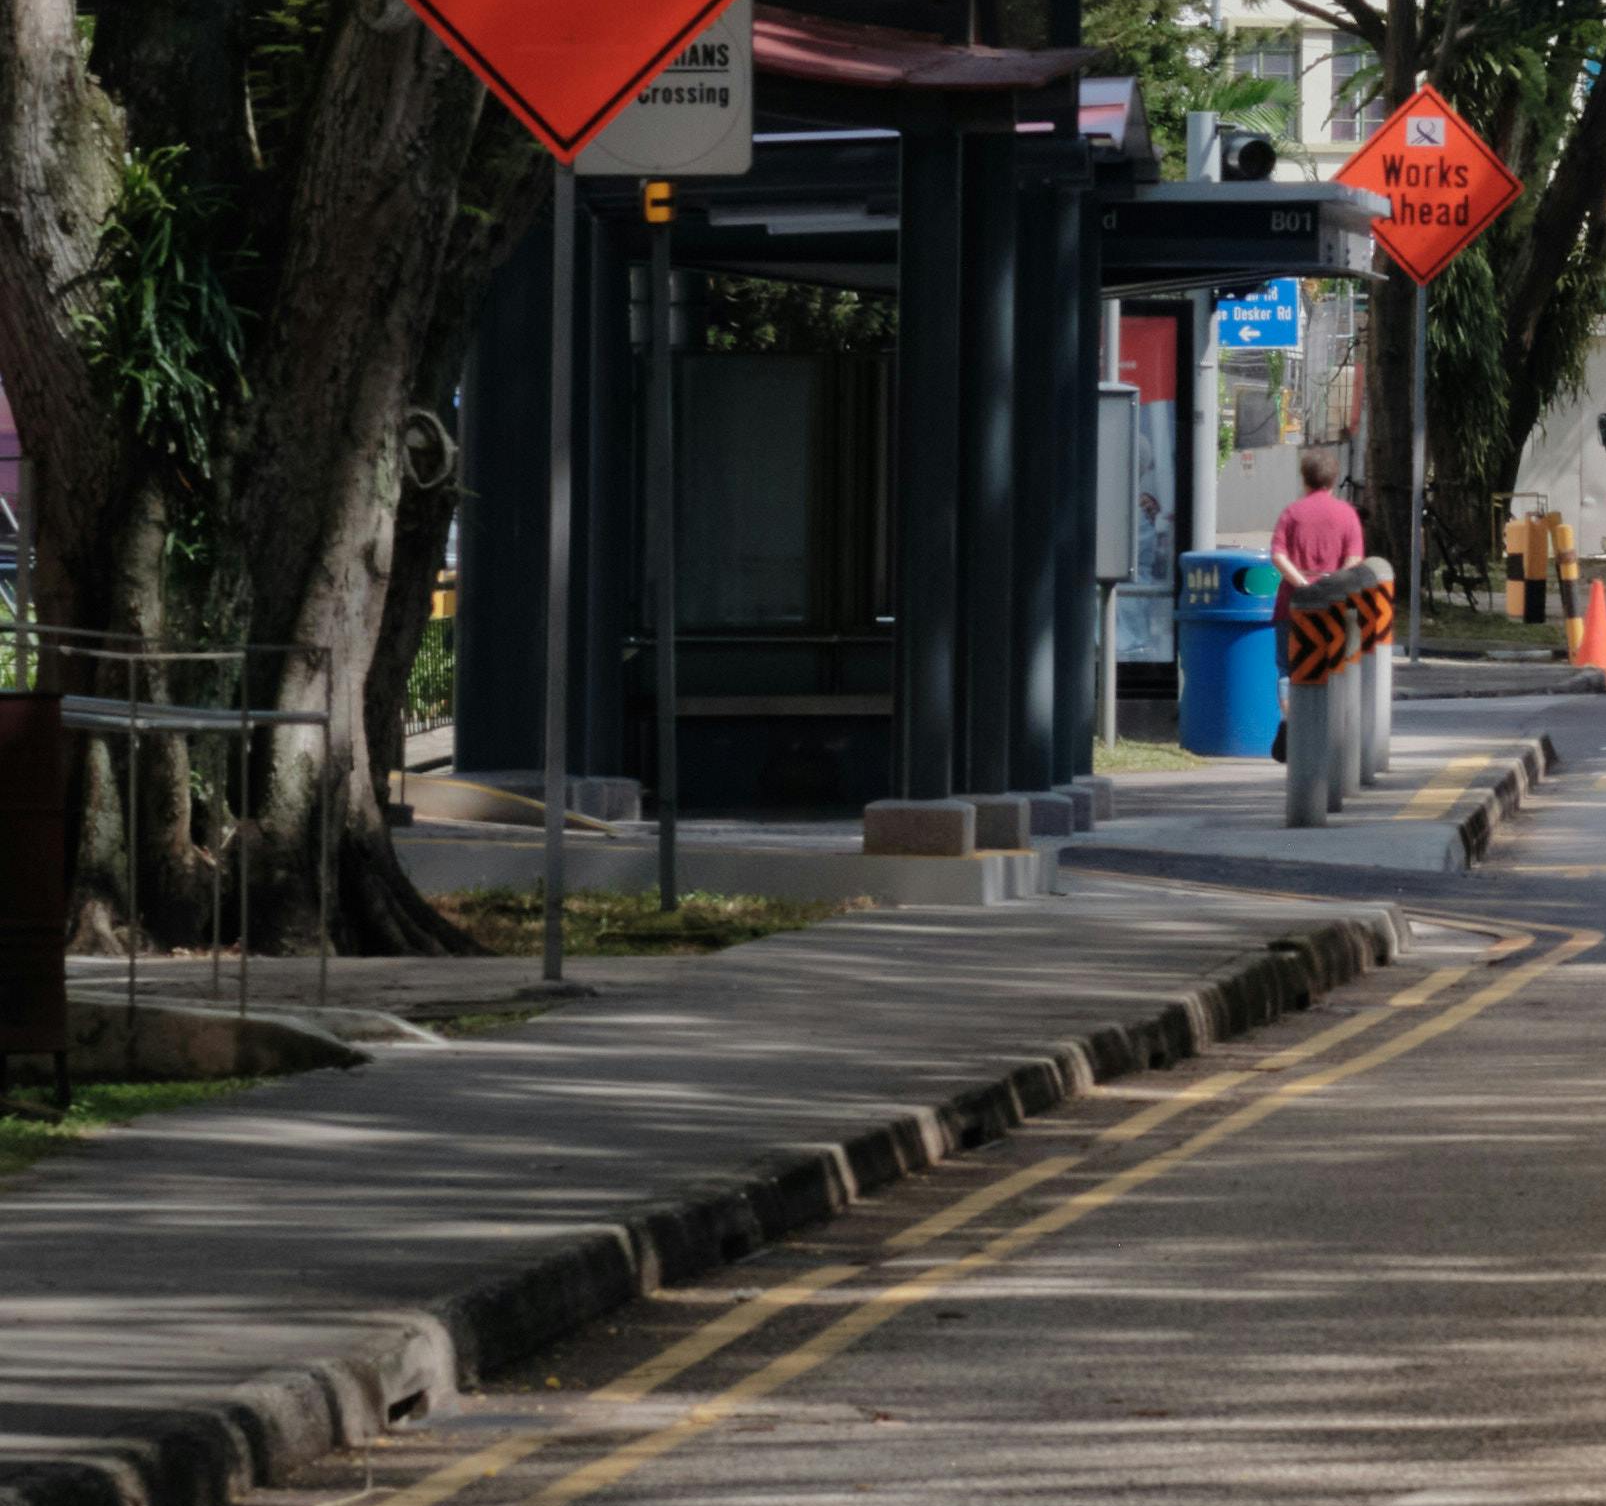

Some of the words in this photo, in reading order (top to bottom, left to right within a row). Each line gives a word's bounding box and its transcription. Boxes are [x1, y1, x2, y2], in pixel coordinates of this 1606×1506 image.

[638, 83, 730, 107] Crossing
[1382, 154, 1469, 188] Works
[1270, 211, 1312, 232] B01
[1380, 193, 1470, 226] Ahead
[1233, 306, 1272, 321] Desker
[1277, 306, 1292, 321] Rd
